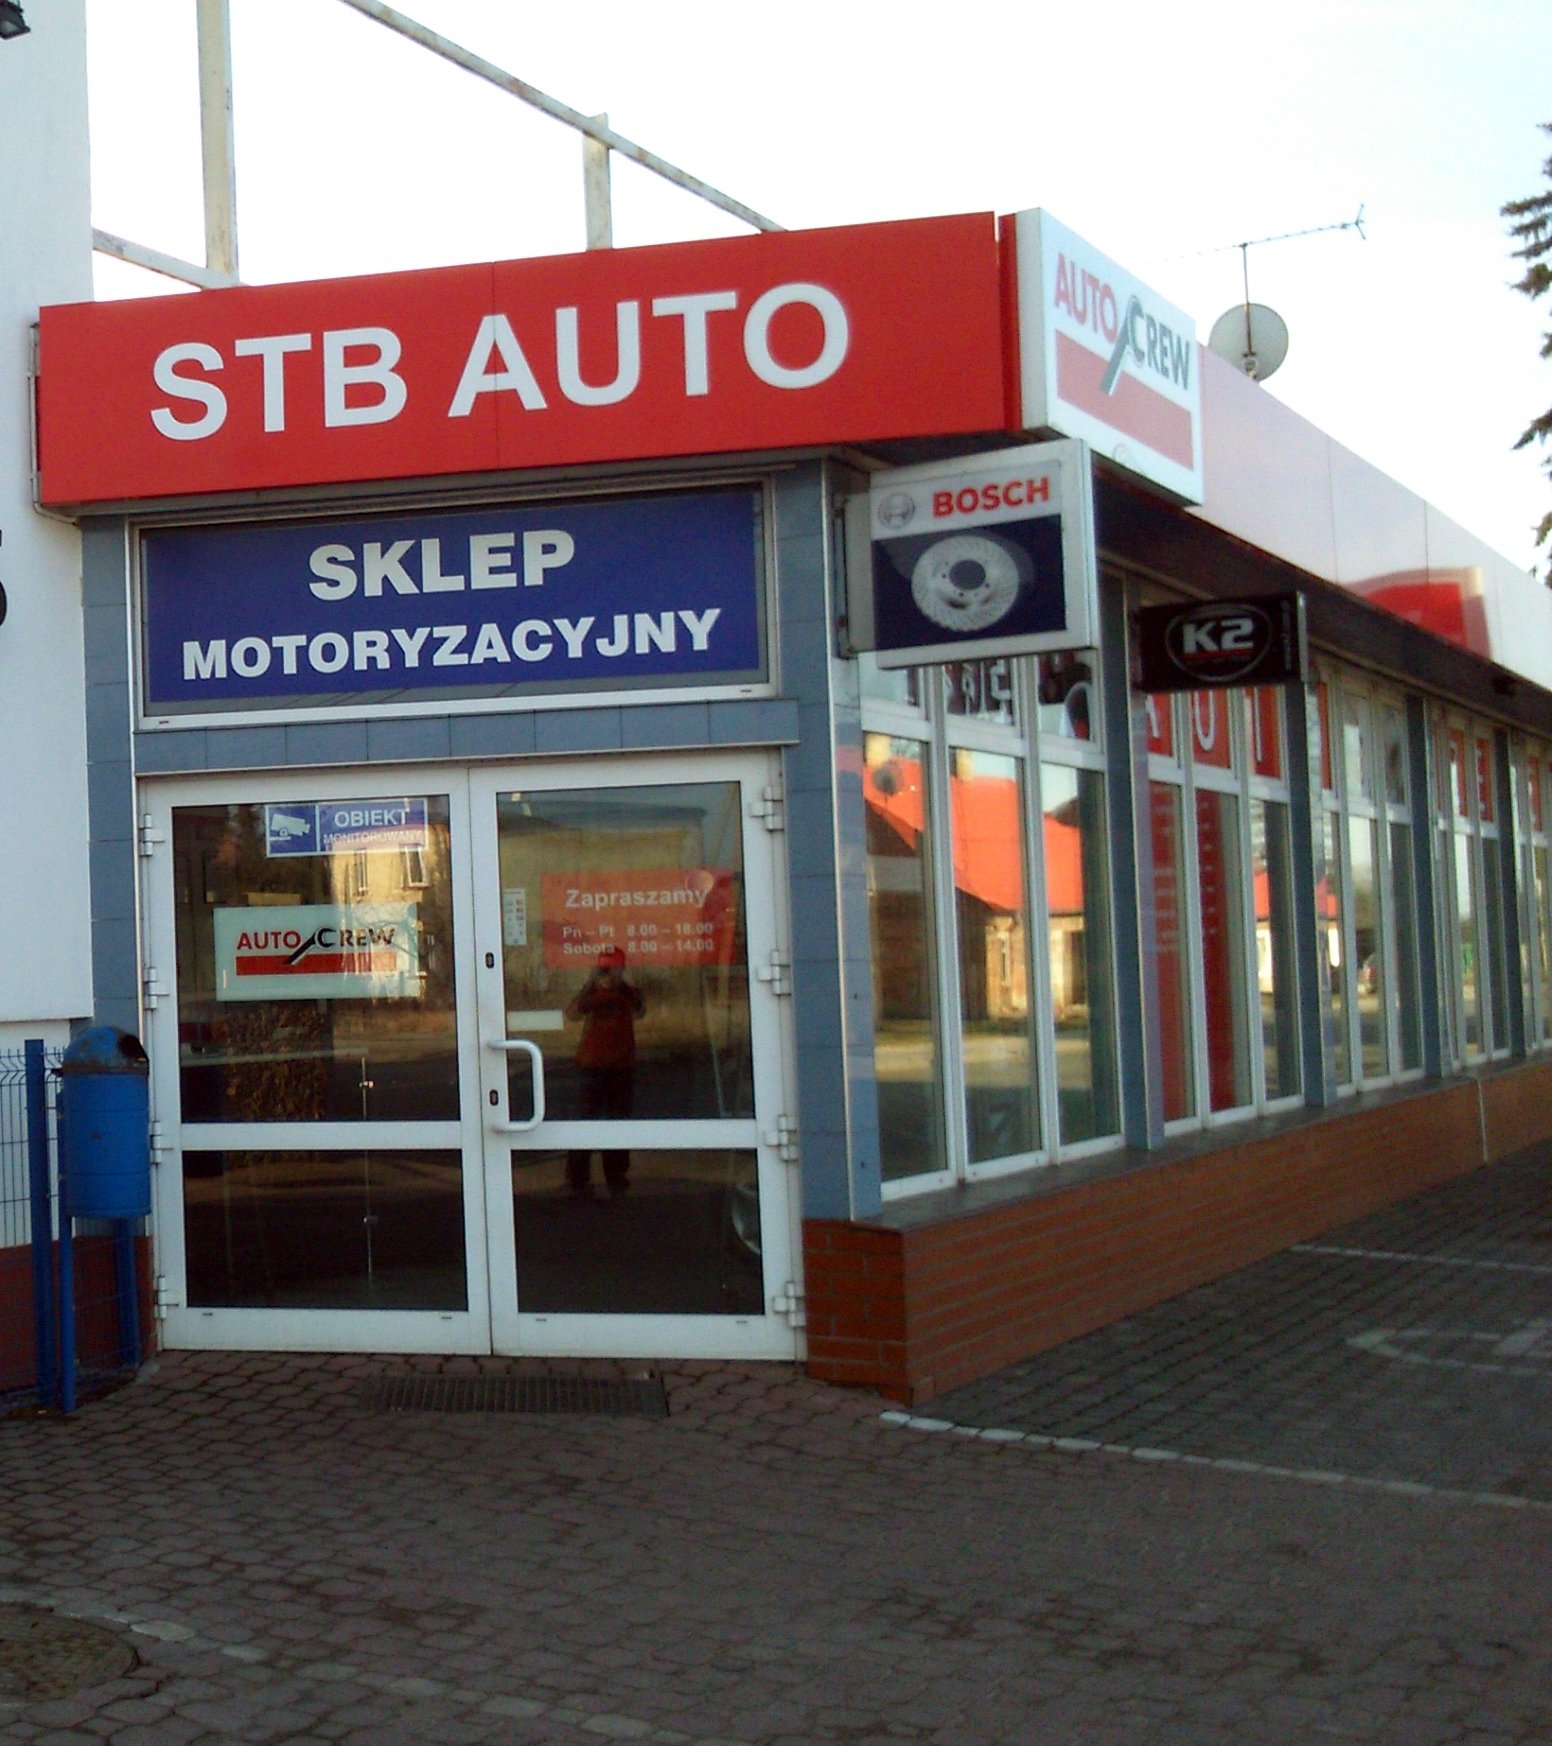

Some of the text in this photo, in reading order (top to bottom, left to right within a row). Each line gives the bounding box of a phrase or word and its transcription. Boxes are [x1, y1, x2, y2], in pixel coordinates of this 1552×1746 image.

[150, 282, 850, 441] STB AUTO
[932, 475, 1050, 518] BOSCH
[308, 530, 575, 602] SKLEP
[182, 608, 722, 682] MOTORYZACYJNY
[1183, 617, 1254, 654] K2
[334, 808, 410, 828] OBIEKT
[565, 888, 709, 911] Zapraszamy
